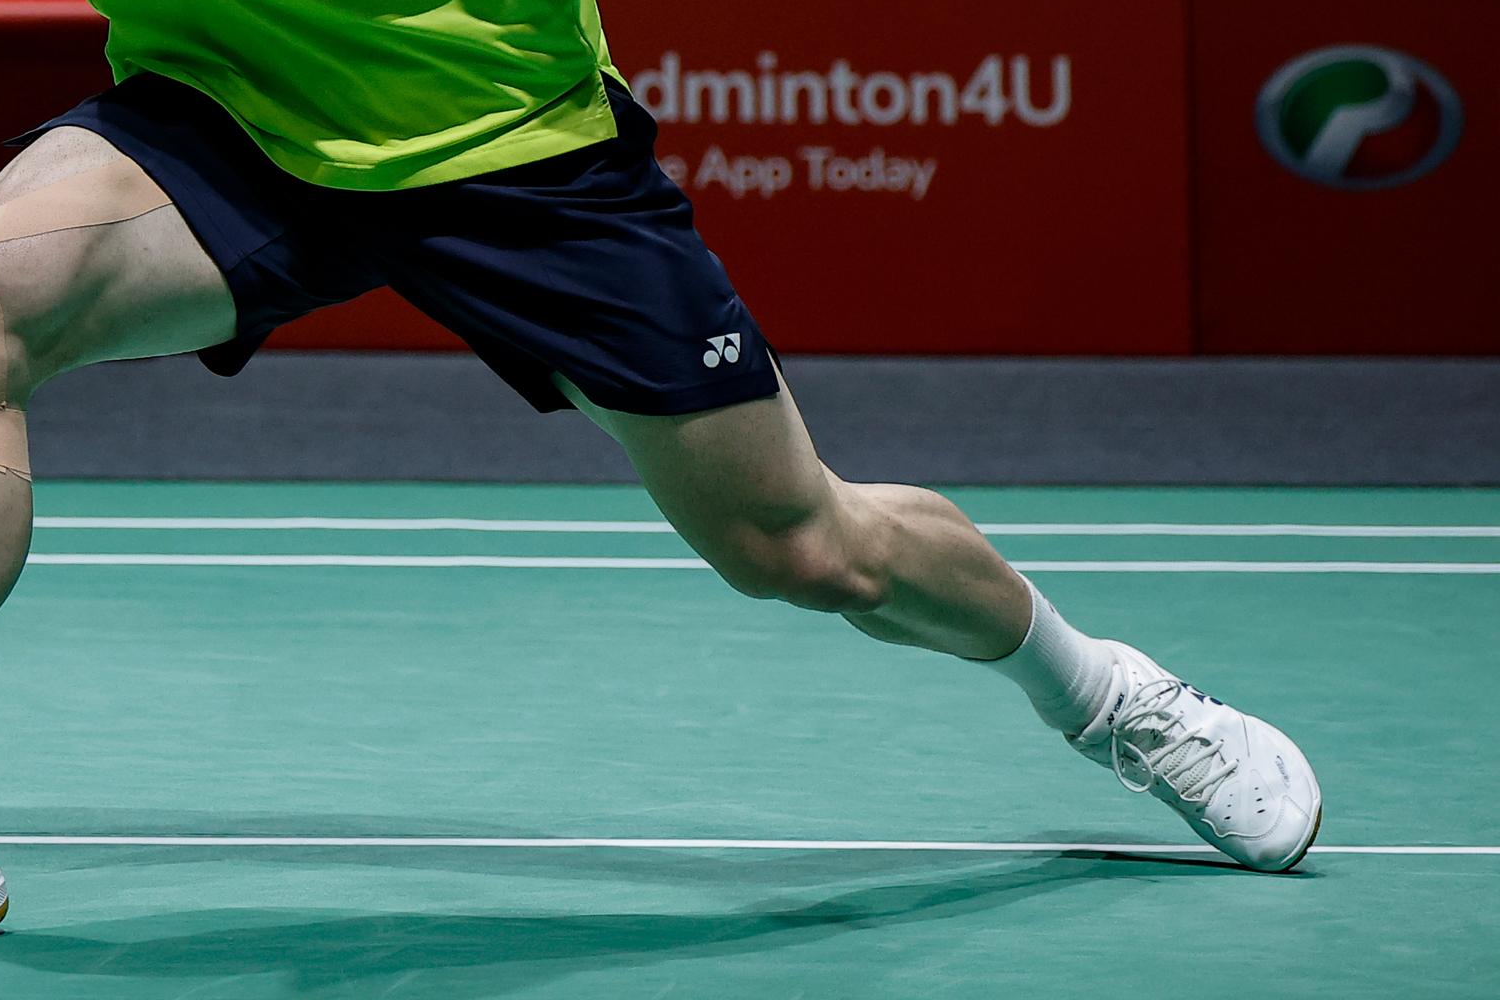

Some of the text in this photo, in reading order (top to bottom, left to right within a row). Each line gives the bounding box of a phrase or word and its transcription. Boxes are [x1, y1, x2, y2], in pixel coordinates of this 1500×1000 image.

[632, 50, 1073, 128] dminton4U
[693, 144, 793, 200] App
[799, 144, 940, 201] Today
